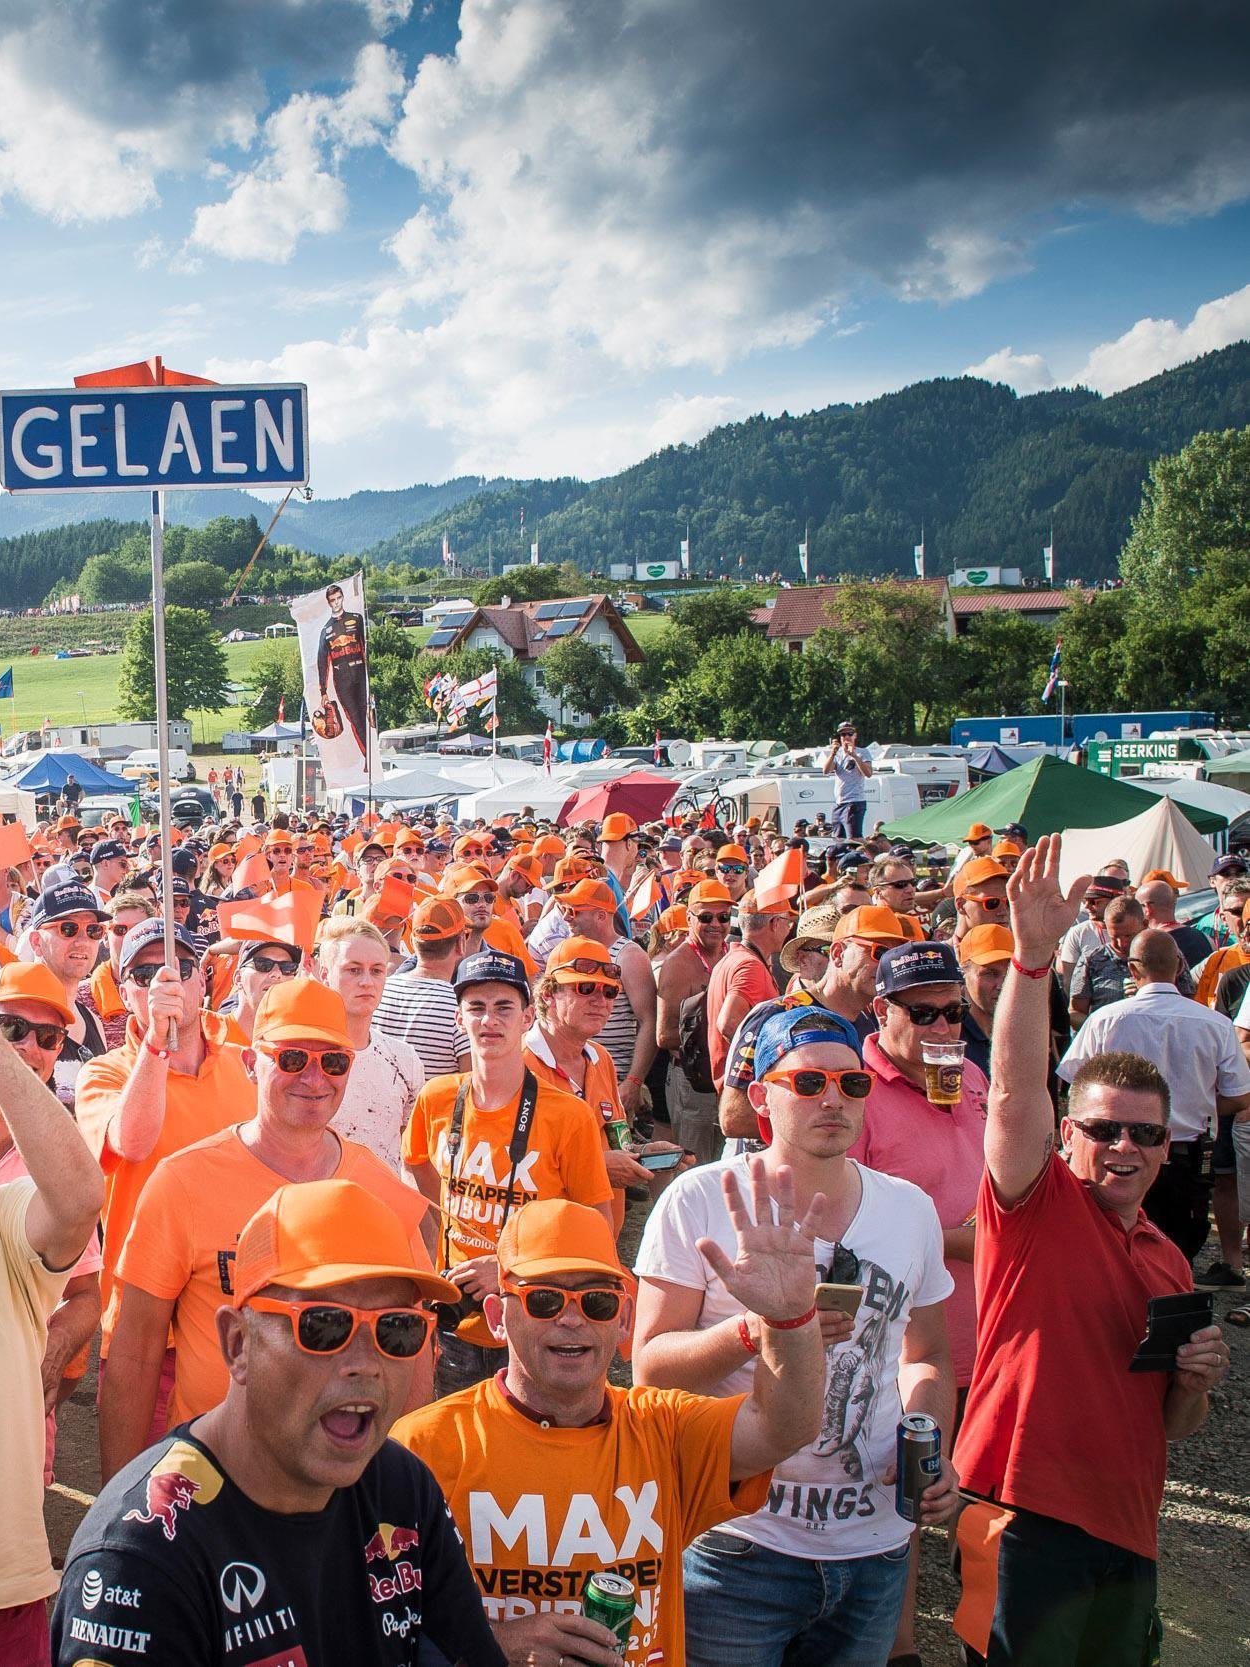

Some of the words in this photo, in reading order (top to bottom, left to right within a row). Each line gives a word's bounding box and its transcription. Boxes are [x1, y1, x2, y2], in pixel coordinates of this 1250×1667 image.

[10, 398, 295, 480] GELAEN
[1113, 743, 1178, 758] BEERKING
[518, 1098, 532, 1132] SONY
[469, 1480, 664, 1567] MAX
[104, 1585, 142, 1608] at&t
[69, 1616, 151, 1654] RENAULT
[224, 1607, 297, 1652] NFINITI
